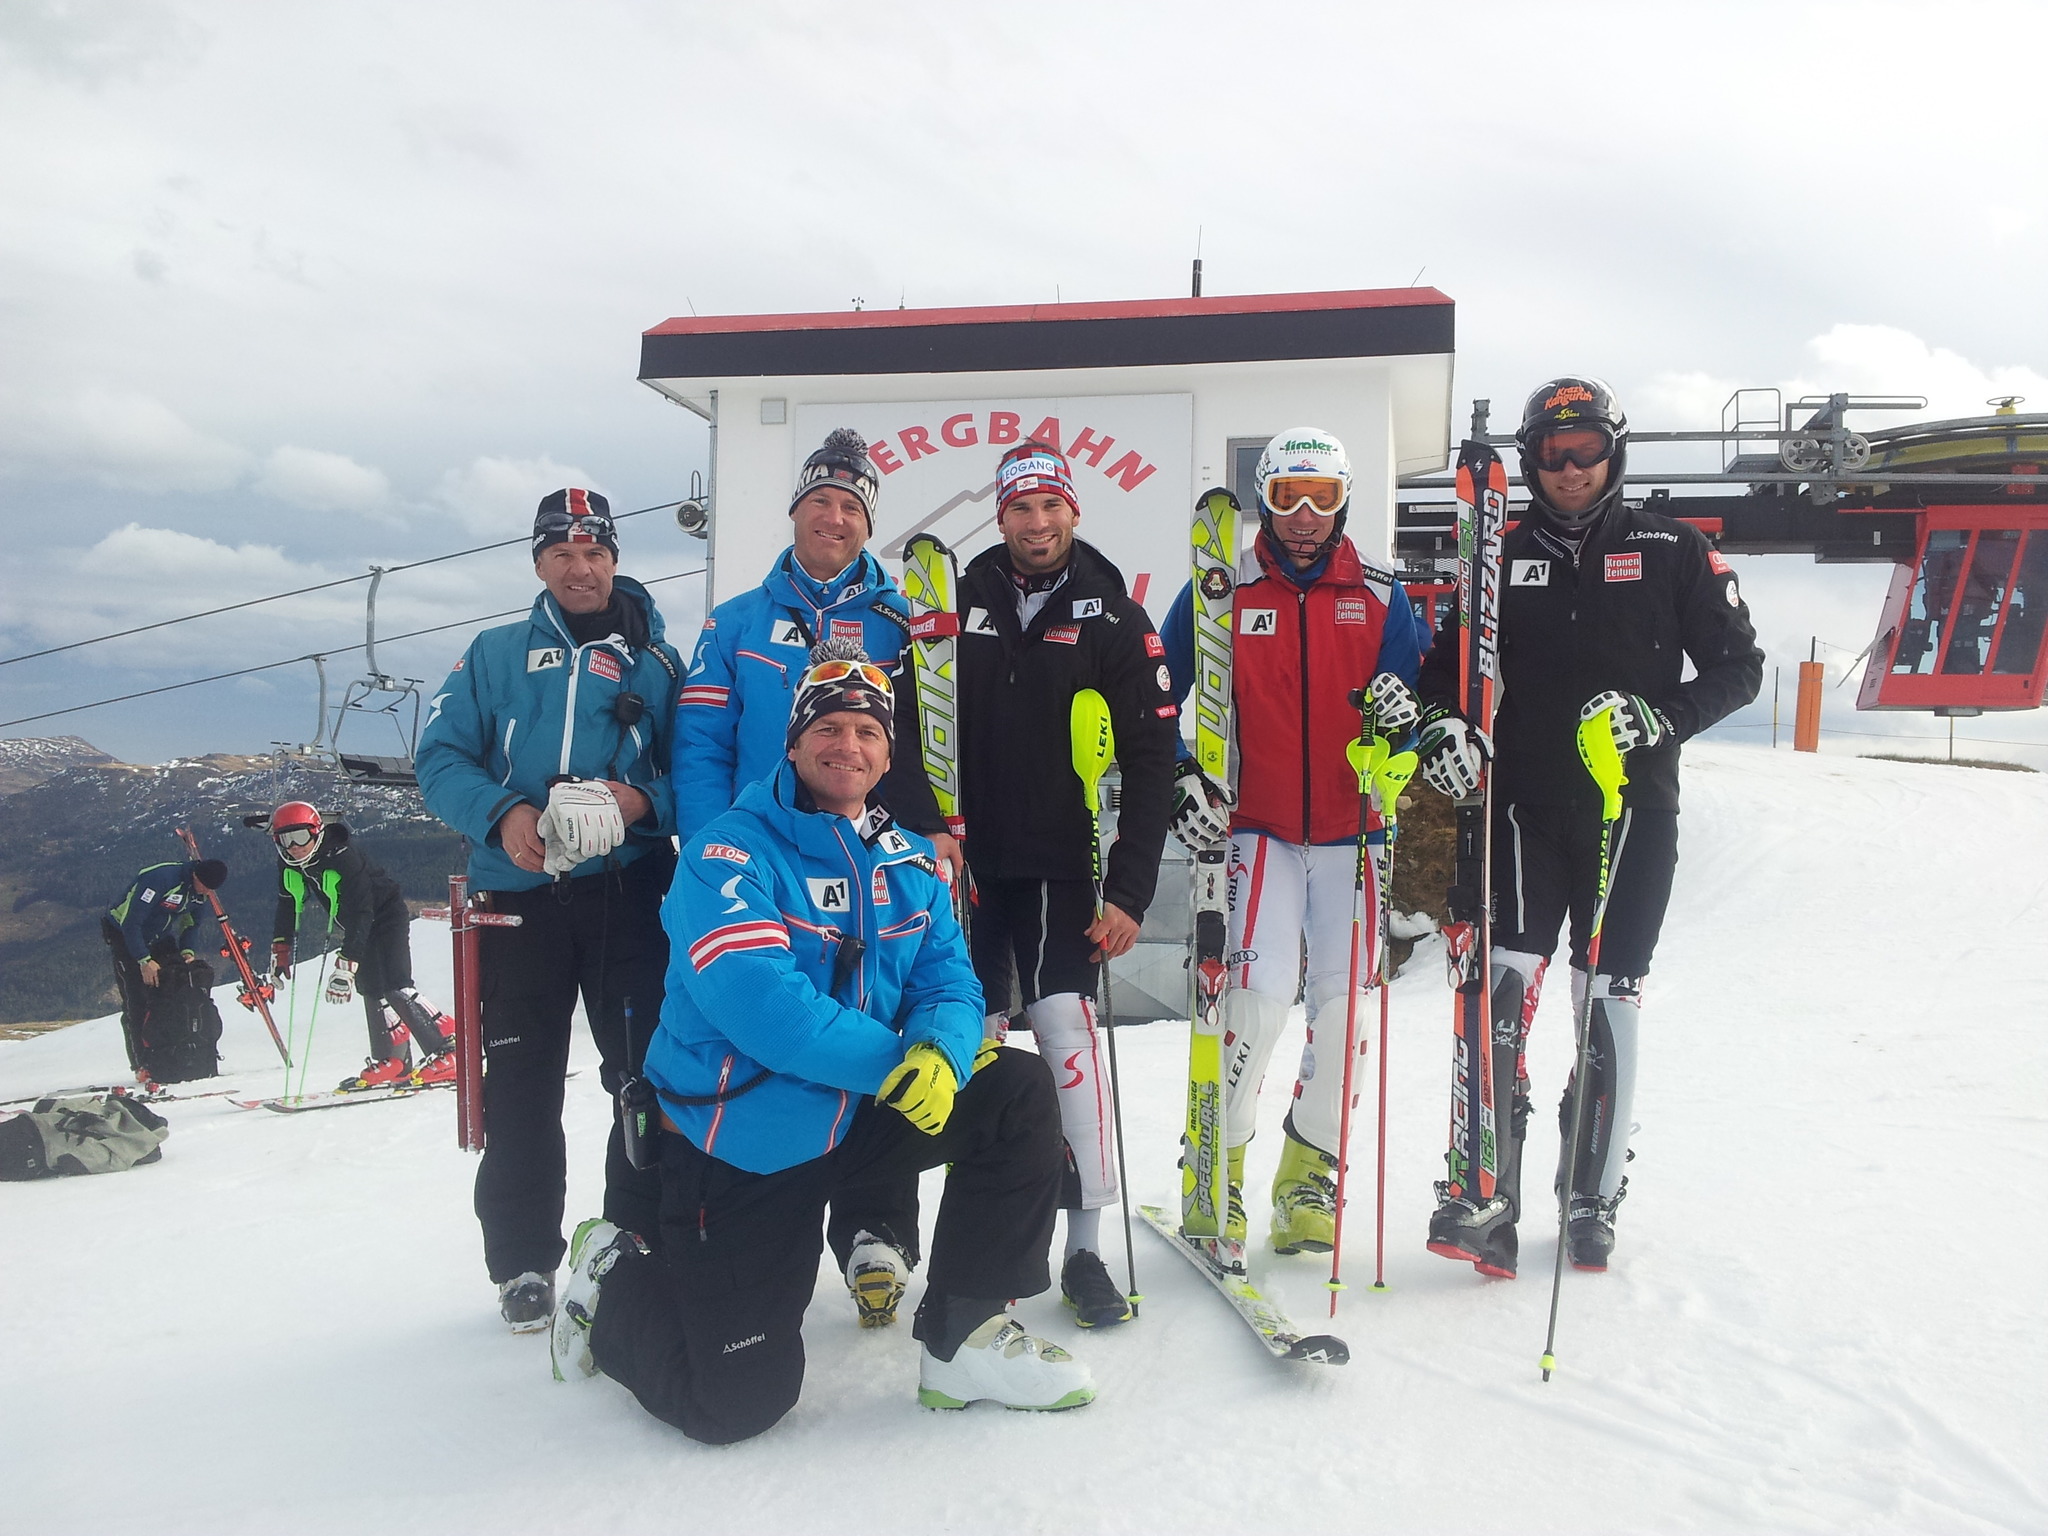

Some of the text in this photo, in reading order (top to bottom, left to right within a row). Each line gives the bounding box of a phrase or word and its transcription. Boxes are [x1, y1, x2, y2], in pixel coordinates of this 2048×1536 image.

[868, 411, 1157, 493] ERGBAHN
[1460, 507, 1474, 562] SL
[1636, 530, 1679, 544] Schöffel
[1607, 556, 1640, 567] Kronen
[1362, 568, 1393, 584] höffel
[1522, 562, 1547, 583] A1
[1607, 566, 1640, 579] Zeitung
[845, 584, 864, 600] A1
[1478, 488, 1505, 681] BLIZZARD
[1336, 601, 1365, 611] Kronen
[1460, 561, 1471, 631] RACING
[1082, 599, 1101, 616] A1
[1336, 610, 1365, 622] Zeitung
[883, 606, 911, 632] Schöff
[980, 617, 995, 631] A
[1104, 612, 1120, 625] ffel
[1252, 612, 1273, 632] A1
[832, 624, 862, 635] Kronen
[1046, 628, 1080, 641] Zeitung
[538, 649, 564, 668] A1
[592, 652, 621, 671] Kronen
[591, 661, 621, 679] Zeitung
[1097, 716, 1108, 758] LEKI
[1579, 729, 1594, 769] LEKI
[1385, 771, 1411, 782] LEK
[561, 784, 613, 798] reusch
[567, 816, 576, 842] reusch
[869, 808, 884, 831] A1
[890, 831, 905, 850] A1
[1226, 843, 1249, 912] AUSTRIA
[1598, 857, 1610, 898] LEKI
[823, 883, 846, 908] A1
[1584, 980, 1594, 1032] CARBON
[494, 1036, 521, 1047] Schöffel
[1229, 1041, 1251, 1088] LEKI
[1190, 1080, 1198, 1132] RACEIGER
[1449, 1036, 1469, 1191] RACING
[1480, 1124, 1495, 1172] 165
[731, 1332, 766, 1353] Schöffel
